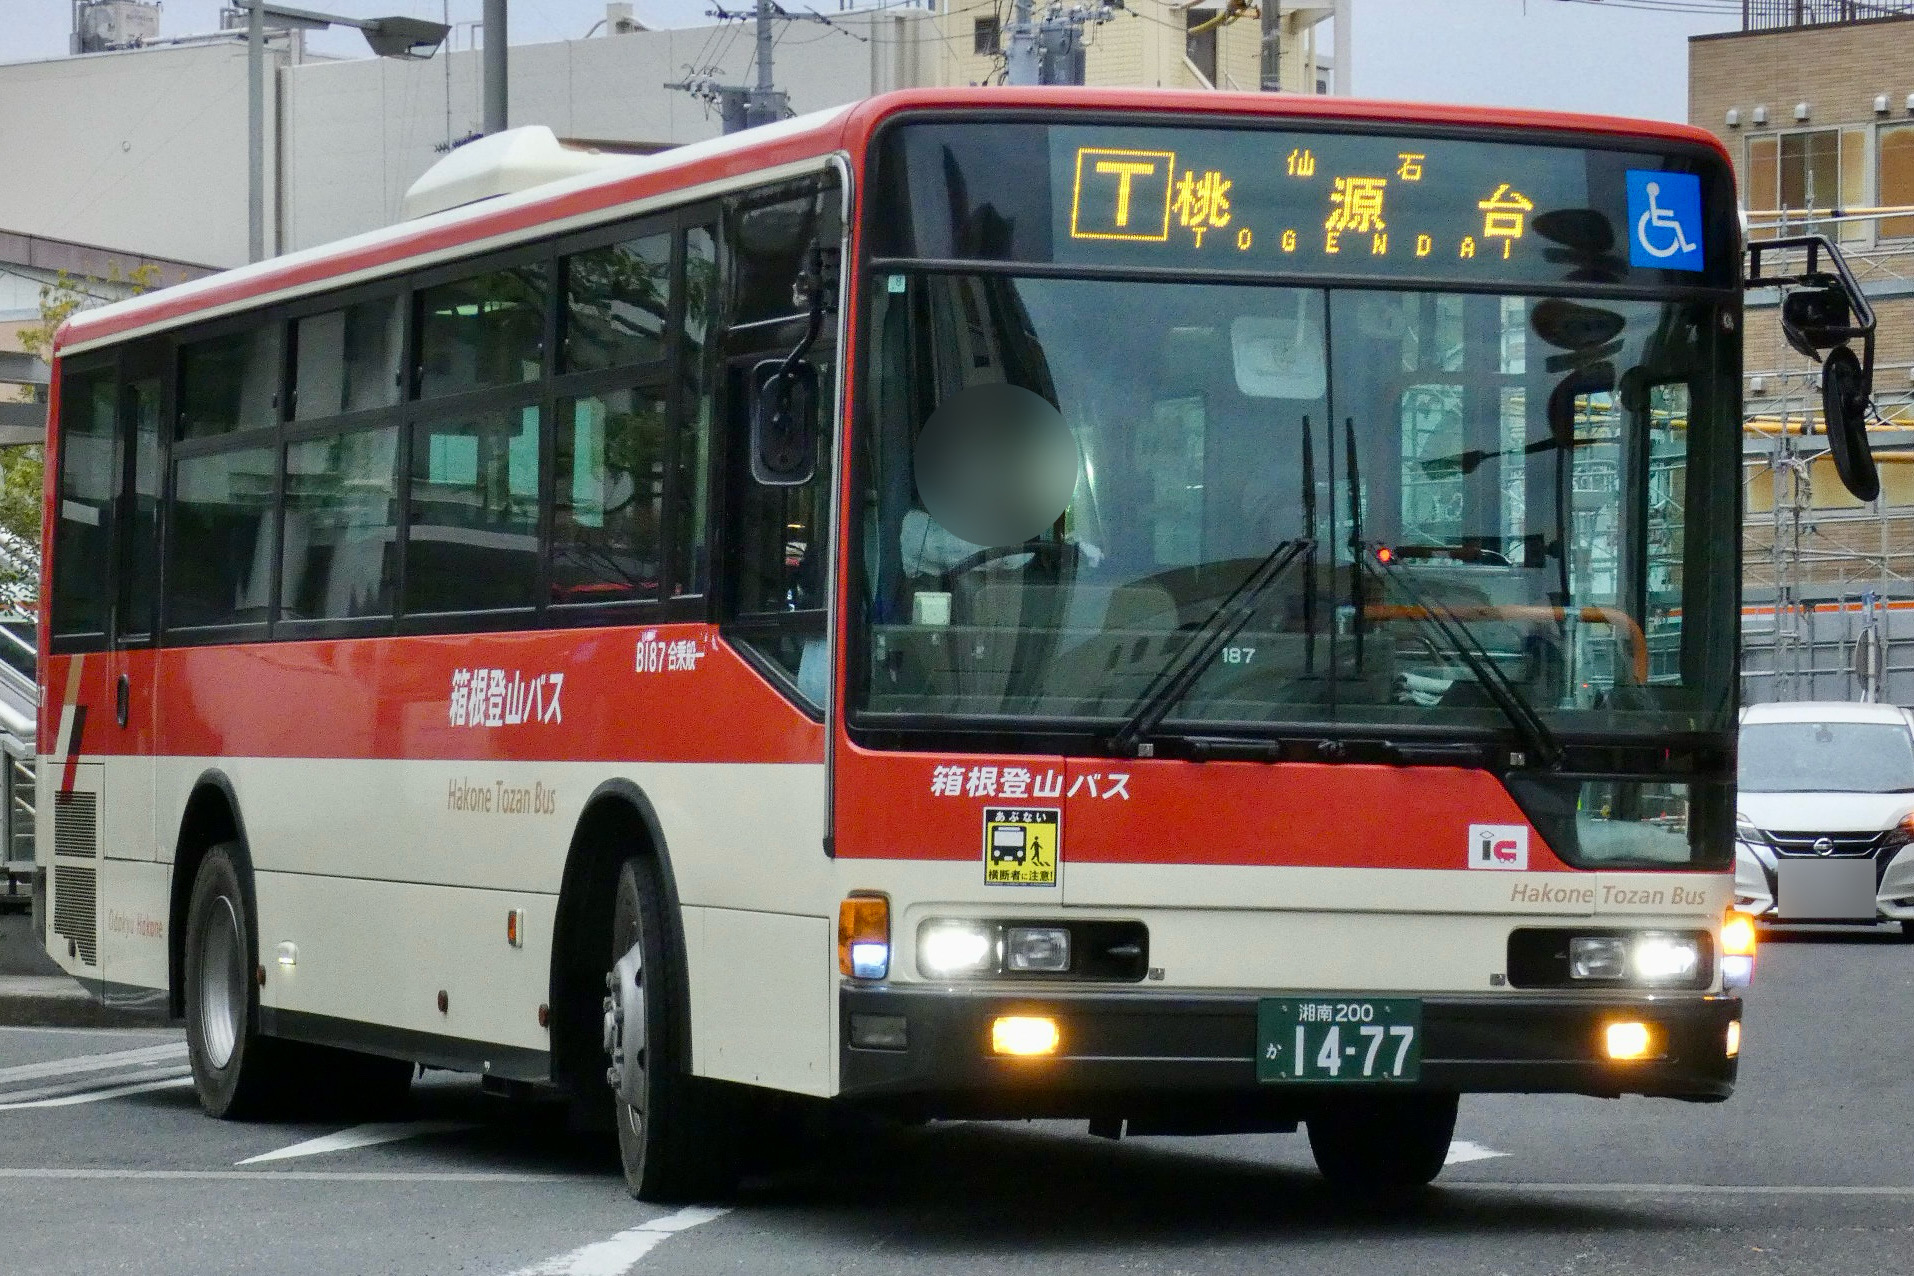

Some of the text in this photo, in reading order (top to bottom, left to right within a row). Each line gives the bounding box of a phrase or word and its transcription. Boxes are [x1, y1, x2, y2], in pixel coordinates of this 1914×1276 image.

[1171, 170, 1534, 238] 桃源台
[1192, 226, 1511, 260] TOGENDAI
[635, 641, 666, 673] B187
[1222, 647, 1256, 664] 187
[450, 668, 564, 727] 箱根登山バス
[448, 777, 556, 815] Hakone Tozan Bus
[930, 765, 1131, 800] 箱根登山バス
[995, 811, 1046, 823] あぶない
[1510, 883, 1706, 906] Hakone Tozan Bus
[1265, 1025, 1414, 1077] か 14-77
